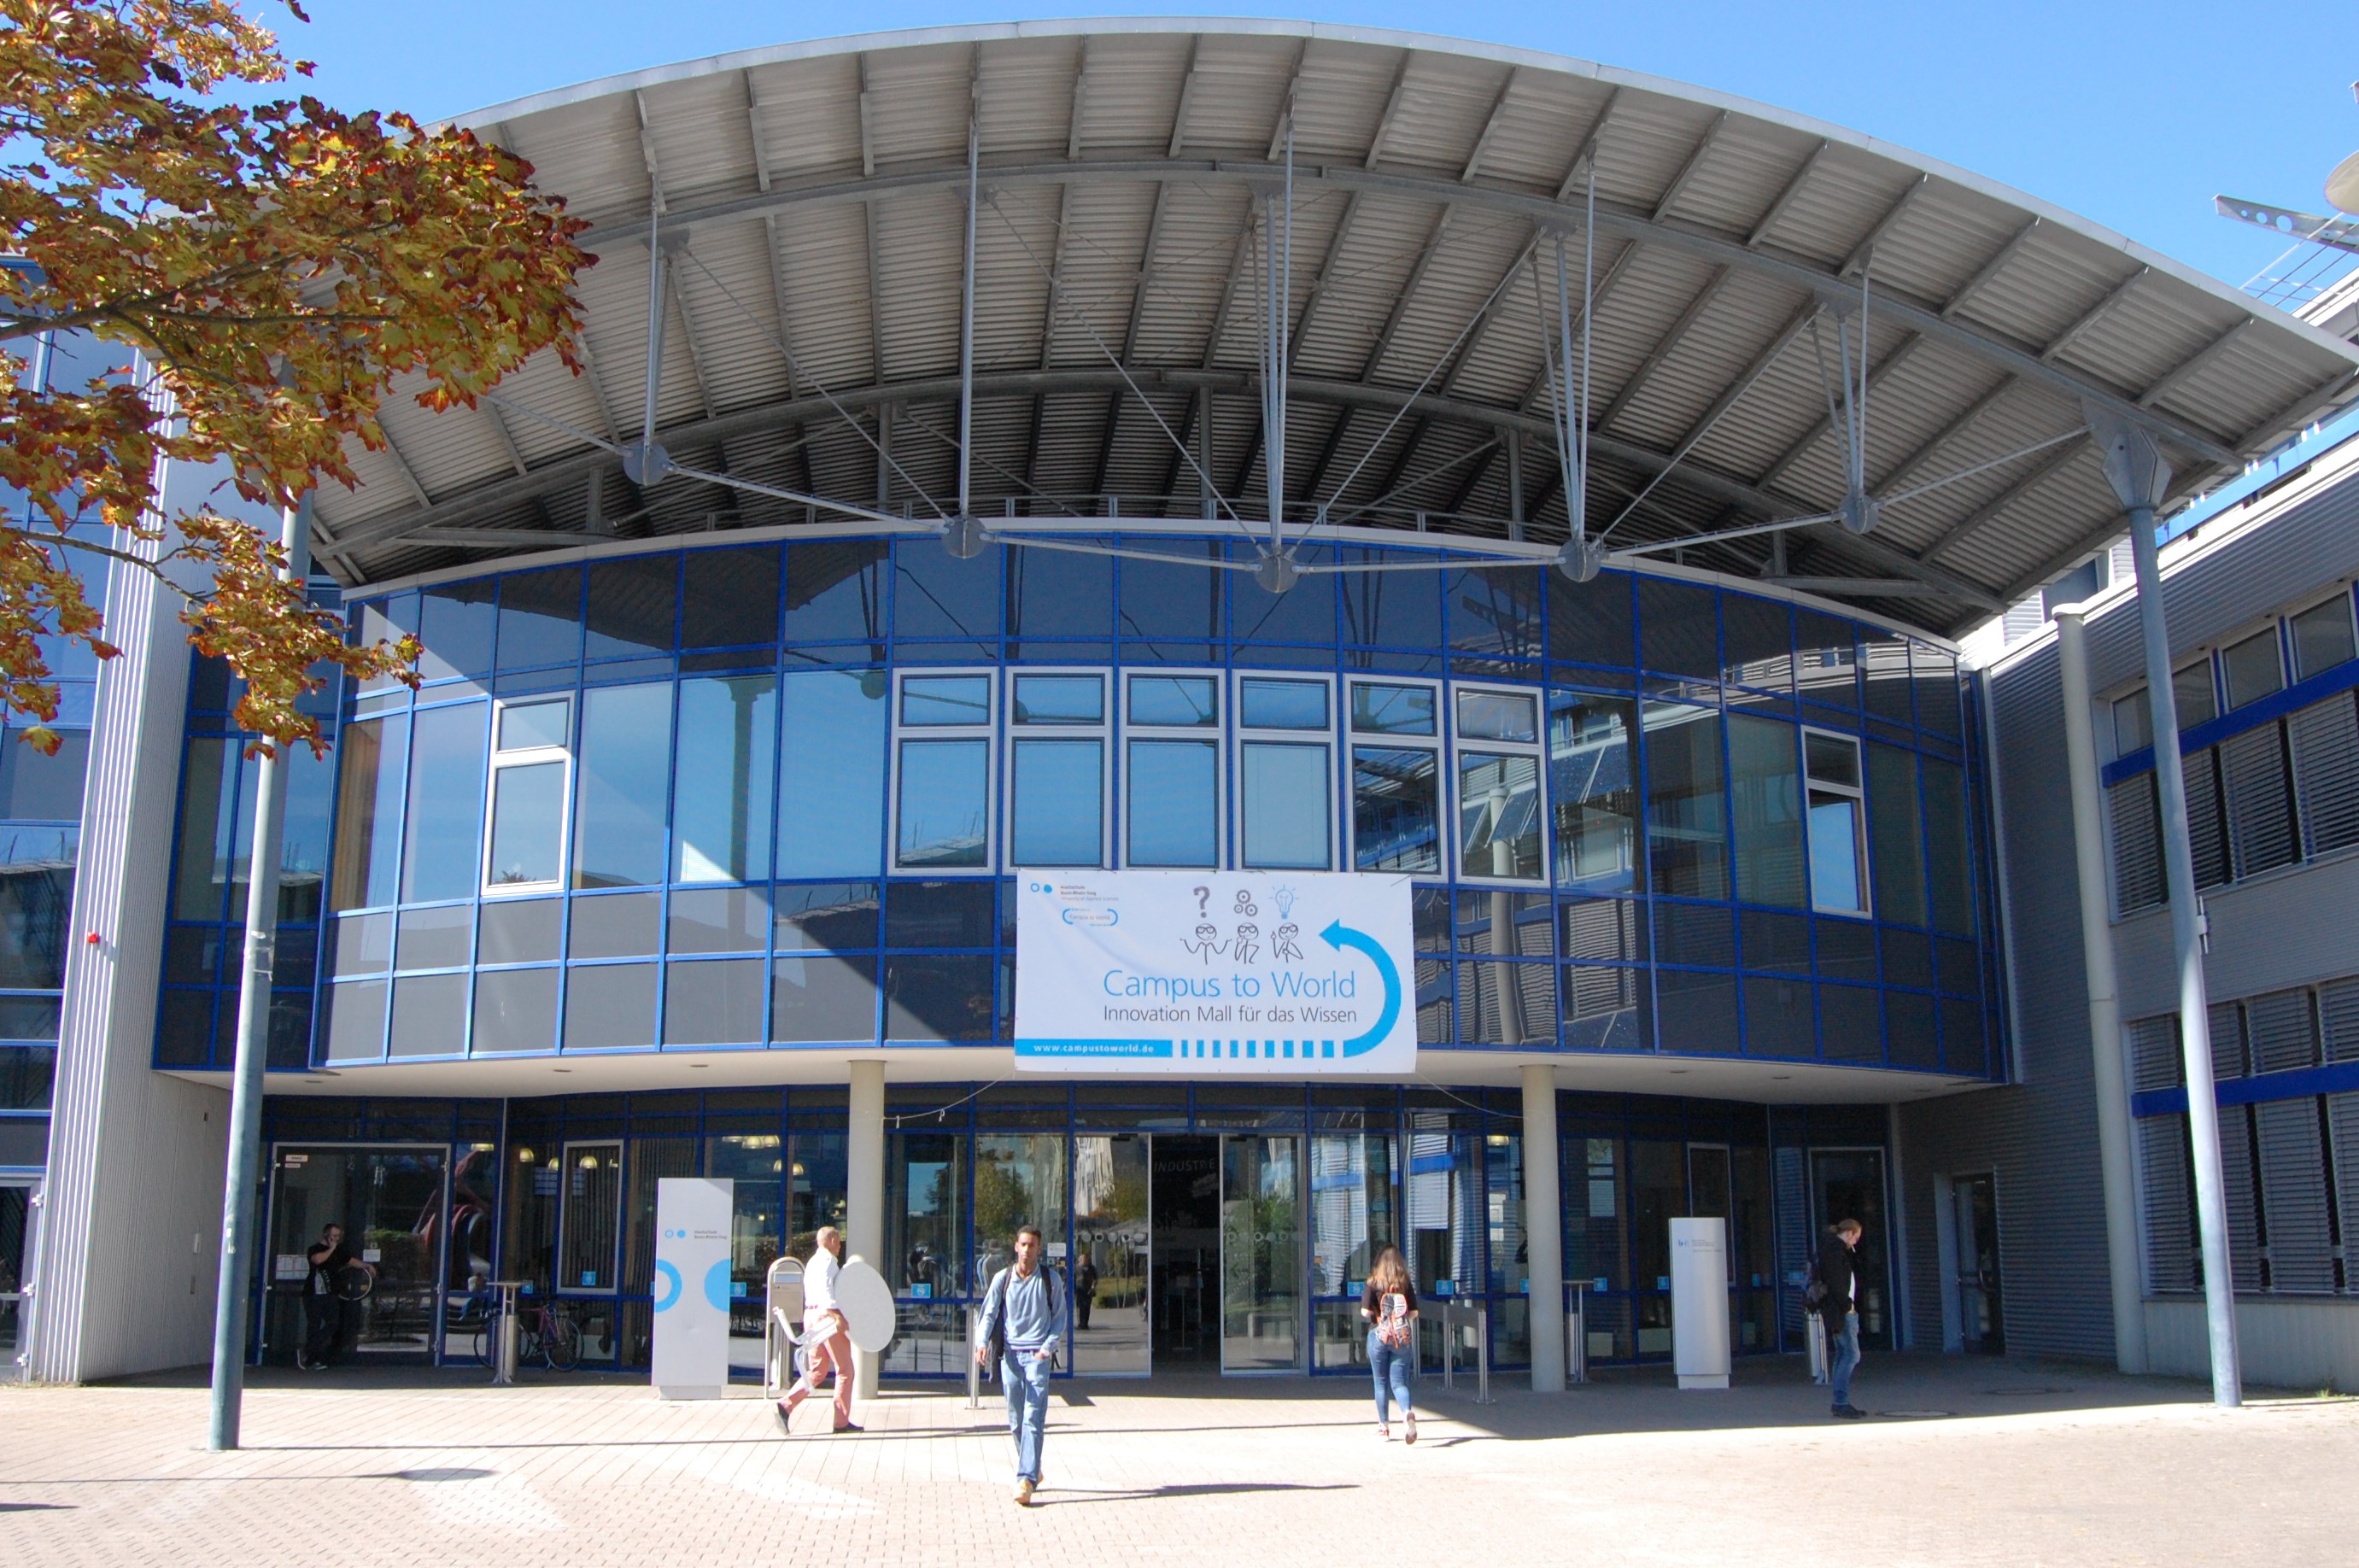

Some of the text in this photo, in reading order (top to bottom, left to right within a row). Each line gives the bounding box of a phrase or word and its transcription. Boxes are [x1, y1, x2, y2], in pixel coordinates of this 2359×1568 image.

[1103, 969, 1355, 1003] Campus to World
[1104, 1005, 1357, 1022] Innovation Mall für das Wissen
[1033, 1044, 1154, 1053] www.campustoworld.de
